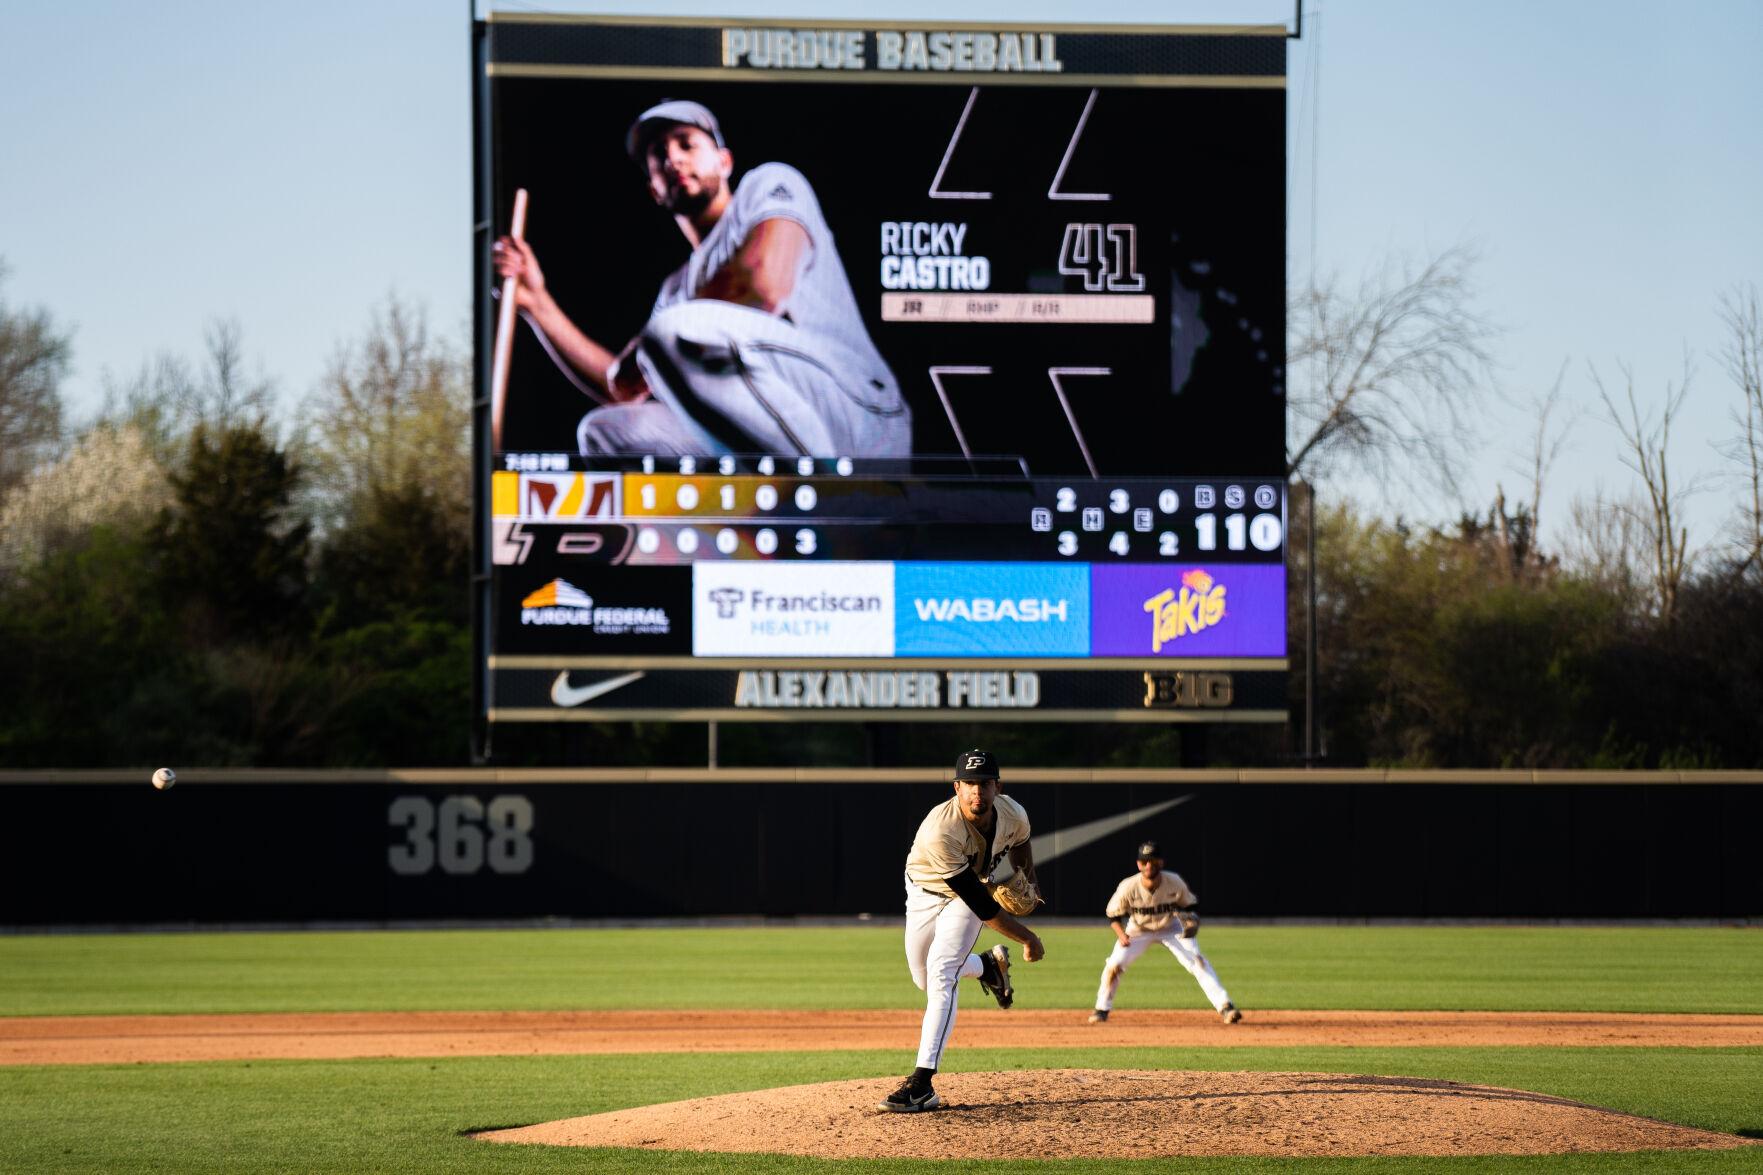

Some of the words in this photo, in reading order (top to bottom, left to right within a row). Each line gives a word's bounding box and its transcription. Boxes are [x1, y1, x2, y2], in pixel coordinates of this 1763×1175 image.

[722, 28, 866, 69] PURDUE
[876, 31, 1063, 72] BASEBALL
[881, 222, 967, 255] RICKY
[1058, 223, 1145, 292] 41
[881, 256, 991, 291] CASTRO
[643, 455, 655, 475] 1
[680, 455, 695, 475] 2
[720, 455, 735, 475] 3
[758, 456, 774, 476] 4
[798, 456, 813, 476] 5
[837, 457, 853, 476] 6
[641, 484, 656, 510] 1
[677, 484, 699, 510] 0
[720, 485, 735, 510] 1
[756, 485, 778, 510] 0
[795, 485, 817, 511] 0
[1056, 487, 1077, 513] 2
[1109, 488, 1130, 514] 3
[1158, 488, 1180, 514] 0
[638, 528, 660, 554] 0
[677, 528, 699, 554] 0
[716, 528, 739, 554] 0
[756, 528, 778, 555] 0
[795, 529, 817, 555] 3
[1057, 531, 1079, 556] 3
[1109, 531, 1130, 556] 4
[1159, 531, 1179, 556] 2
[750, 589, 882, 613] Franciscan
[914, 598, 1068, 622] WABASH
[1143, 571, 1227, 654] Takis
[521, 608, 592, 626] PURDUE
[593, 607, 666, 626] FEDERAL
[750, 619, 830, 636] HEALTH
[735, 670, 941, 708] ALEXANDER
[947, 670, 1040, 708] FIELD
[965, 756, 986, 770] P
[388, 795, 535, 875] 368
